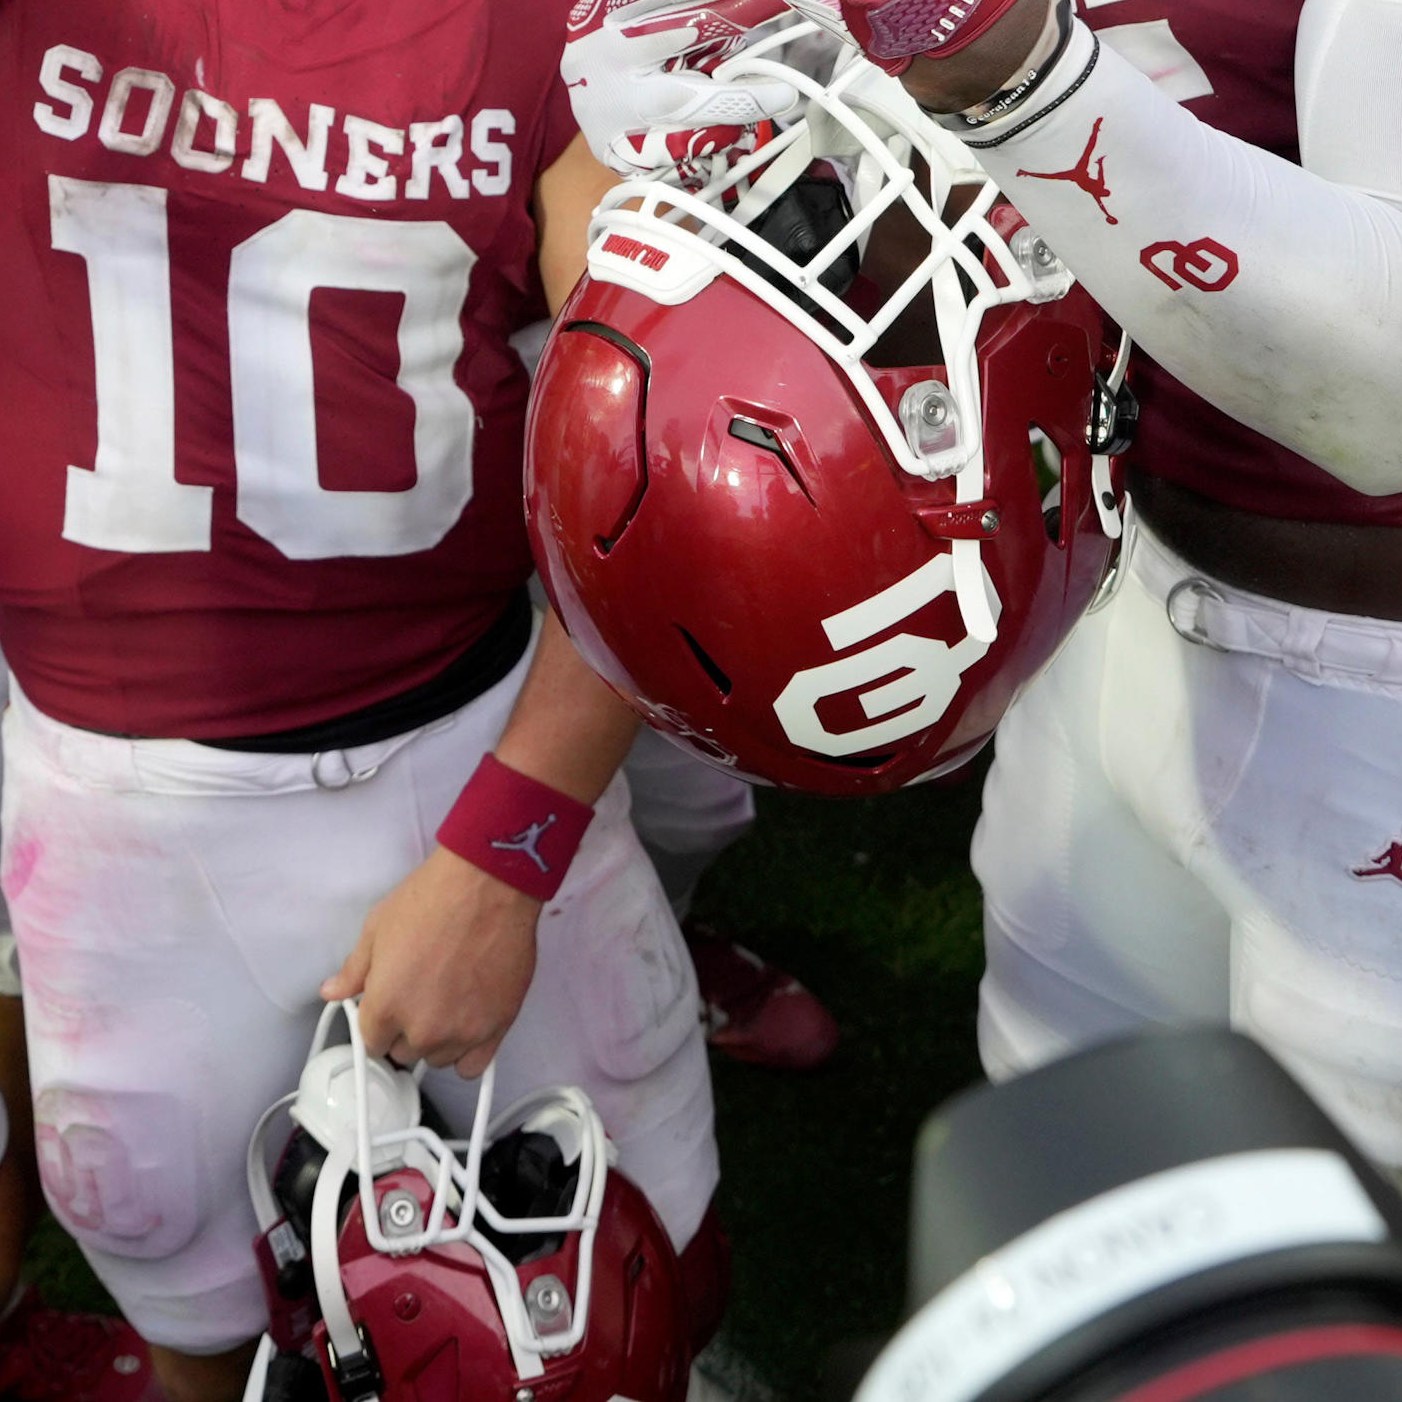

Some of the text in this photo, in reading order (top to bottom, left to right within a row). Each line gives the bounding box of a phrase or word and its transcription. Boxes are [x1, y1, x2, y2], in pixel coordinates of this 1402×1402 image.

[32, 44, 516, 201] SOONERS
[1140, 235, 1239, 292] OU
[48, 174, 479, 561] 10
[772, 553, 1002, 757] OU
